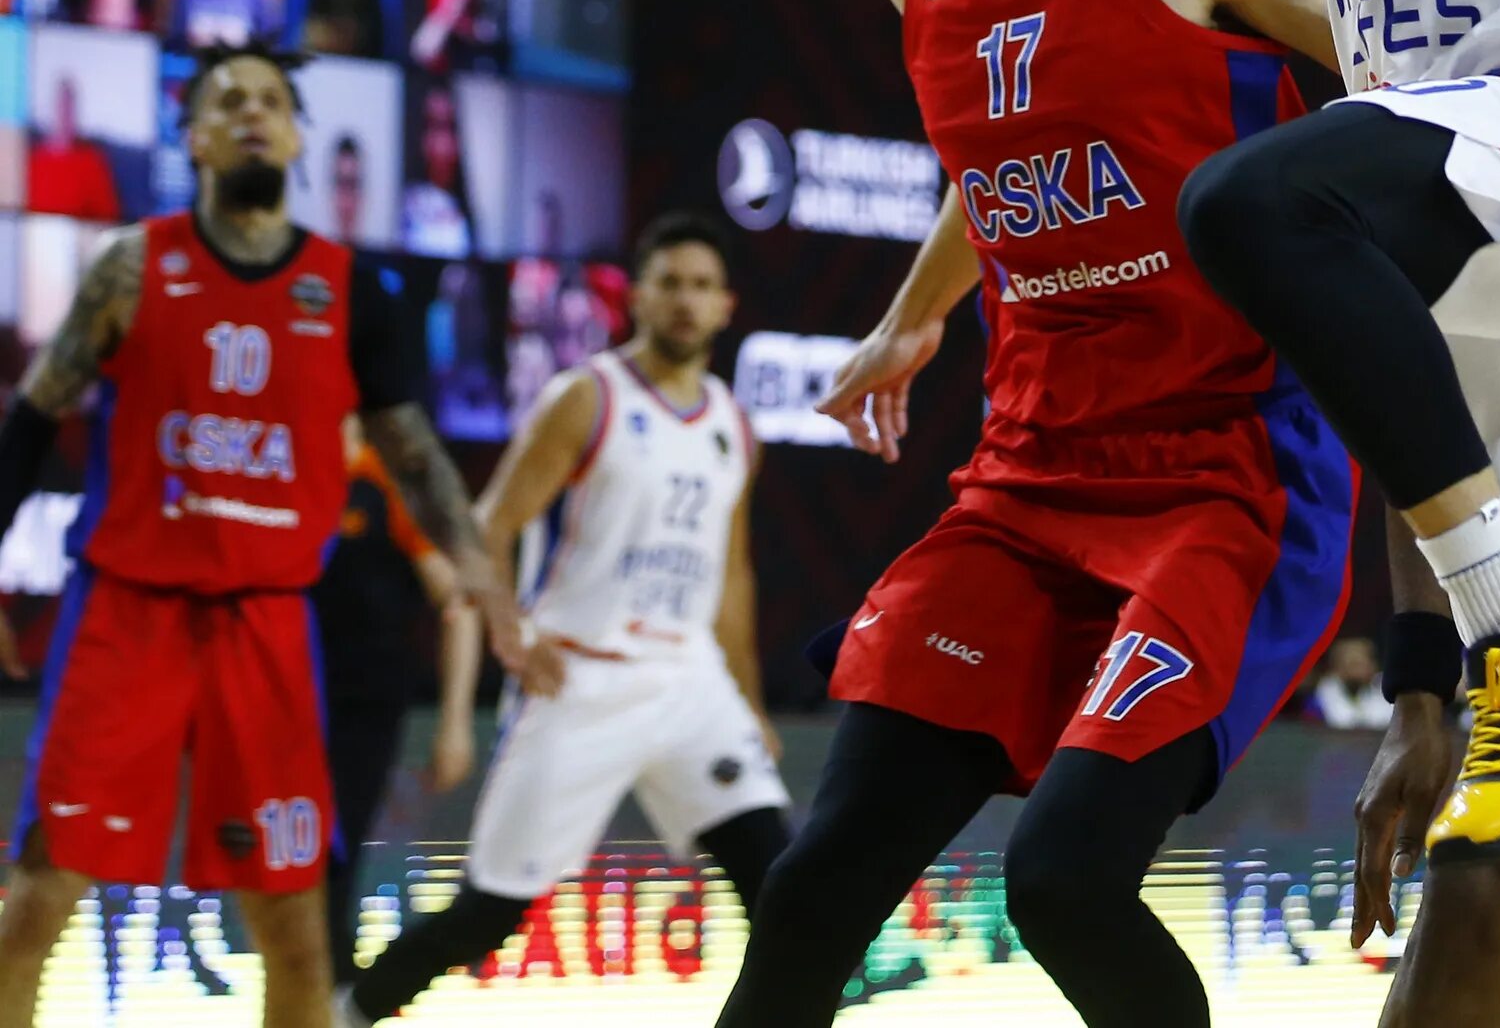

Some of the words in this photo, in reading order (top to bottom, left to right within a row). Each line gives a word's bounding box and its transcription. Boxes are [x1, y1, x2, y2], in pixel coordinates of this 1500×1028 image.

[977, 11, 1046, 120] 17
[961, 140, 1147, 243] CSKA
[1010, 250, 1171, 300] Rostelecom
[204, 322, 272, 396] 10
[156, 410, 296, 483] CSKA
[936, 636, 985, 665] UAC
[1081, 631, 1194, 722] 17
[256, 796, 322, 870] 10
